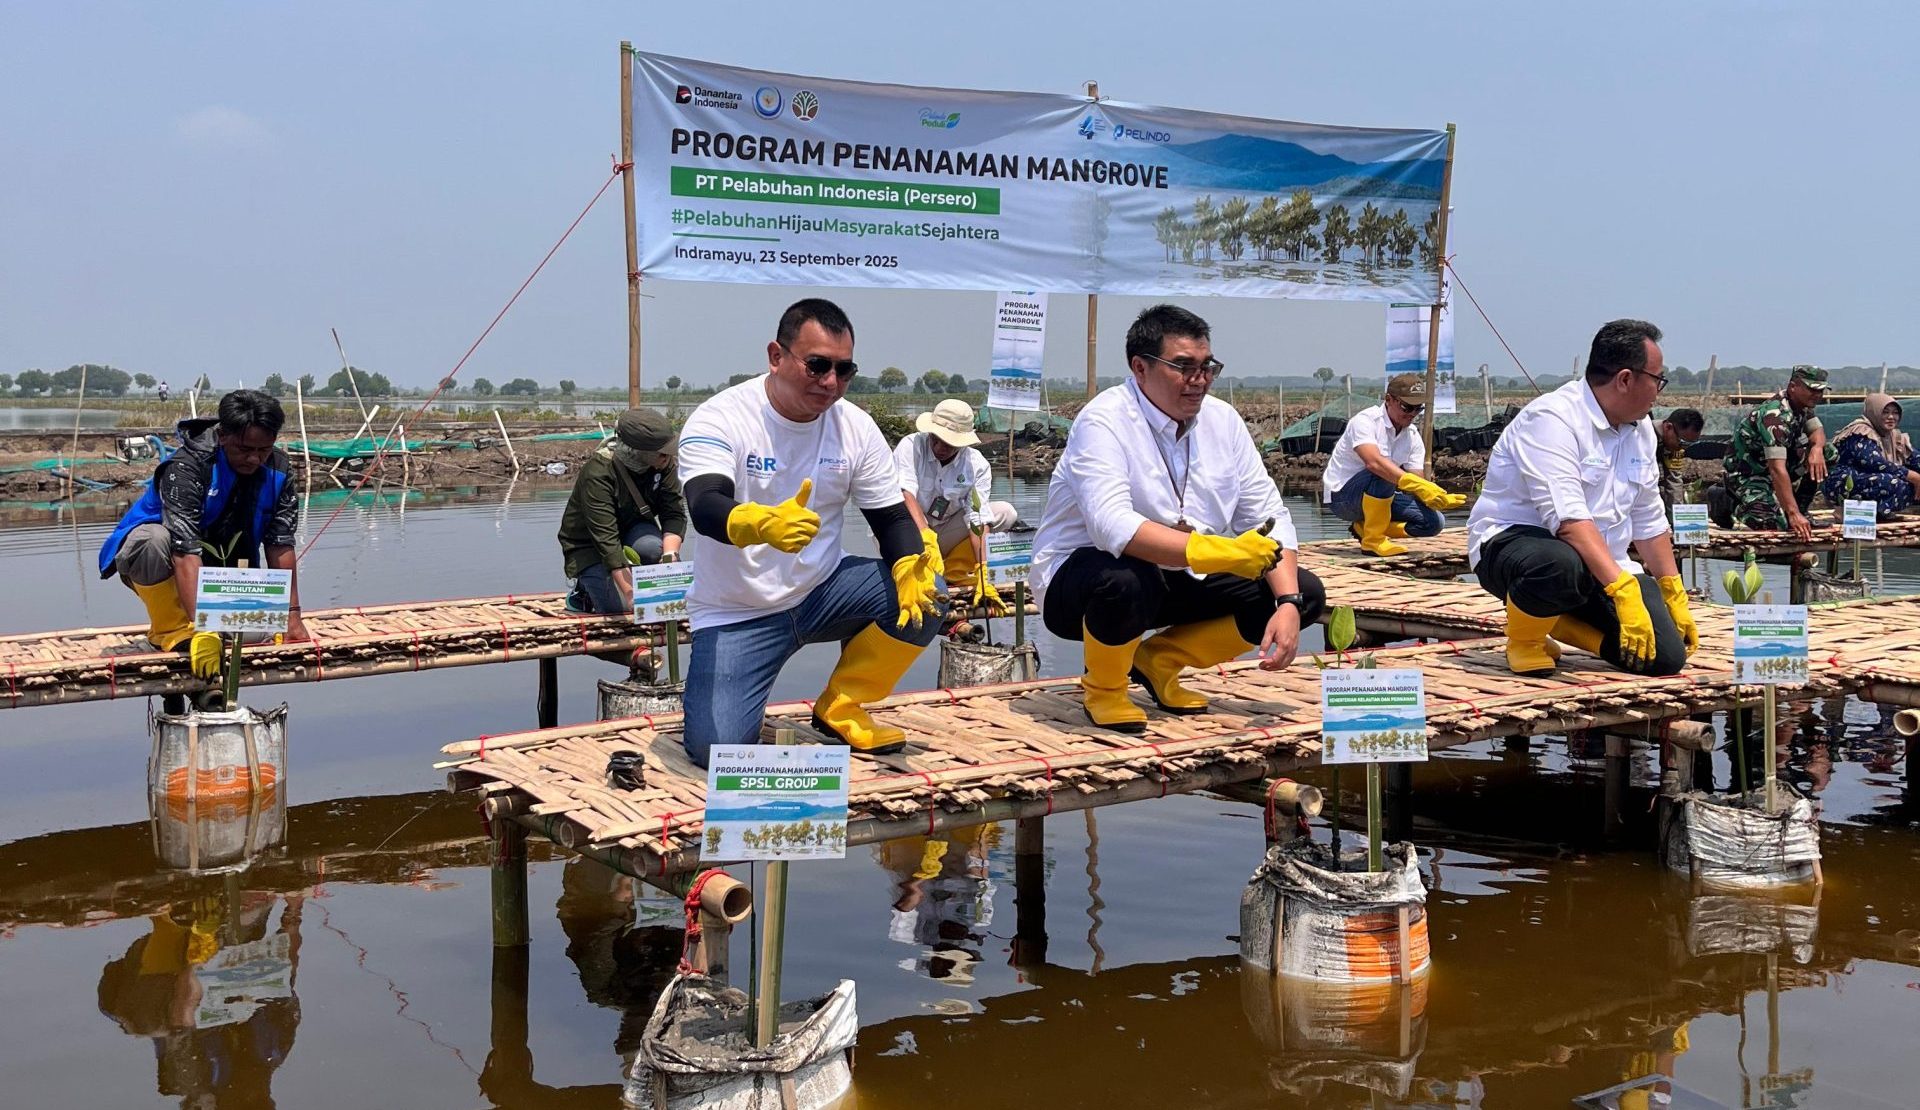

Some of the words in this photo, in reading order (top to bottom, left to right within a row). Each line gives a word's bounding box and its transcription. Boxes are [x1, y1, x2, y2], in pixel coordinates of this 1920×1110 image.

[694, 86, 743, 101] Danantara
[694, 97, 738, 110] Indonesia
[1126, 128, 1171, 142] PELINDO
[671, 127, 825, 166] PROGRAM
[833, 142, 1019, 179] PENANAMAN
[1027, 155, 1169, 190] MANGROVE
[696, 174, 718, 190] PT
[722, 177, 813, 198] Pelabuhan
[818, 183, 899, 202] Indonesia
[904, 188, 977, 210] (Persero)
[671, 208, 1000, 241] #PelabuhanHijauMasyarakatSejahtera
[674, 245, 757, 265] Indramayu,
[759, 250, 777, 264] 23
[779, 251, 861, 268] September
[864, 255, 899, 268] 2025
[999, 308, 1044, 318] PENANAMAN
[1004, 302, 1040, 310] PROGRAM
[1000, 316, 1040, 324] MANGROVE
[746, 454, 776, 472] ESR
[740, 778, 772, 788] SPSL
[775, 778, 818, 788] GROUP
